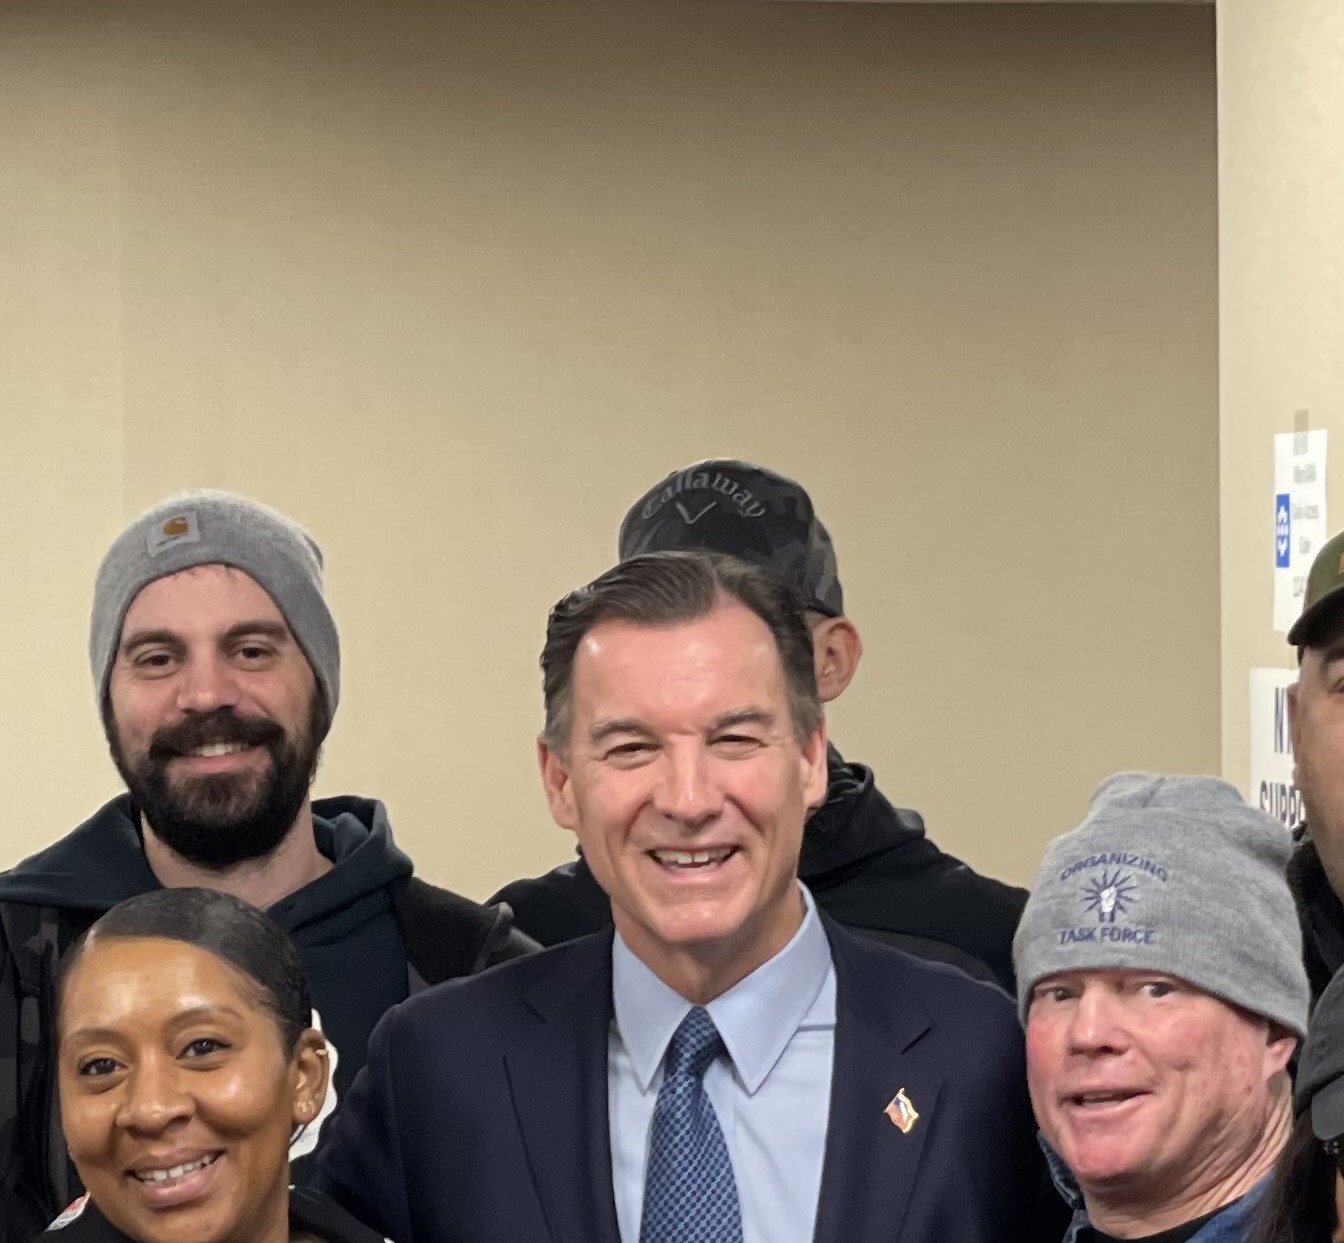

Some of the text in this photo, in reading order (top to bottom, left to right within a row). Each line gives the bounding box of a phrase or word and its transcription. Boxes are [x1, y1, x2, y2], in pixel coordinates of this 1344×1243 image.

[1060, 852, 1168, 883] ORGANIZING
[1060, 927, 1156, 945] TASK FORCE
